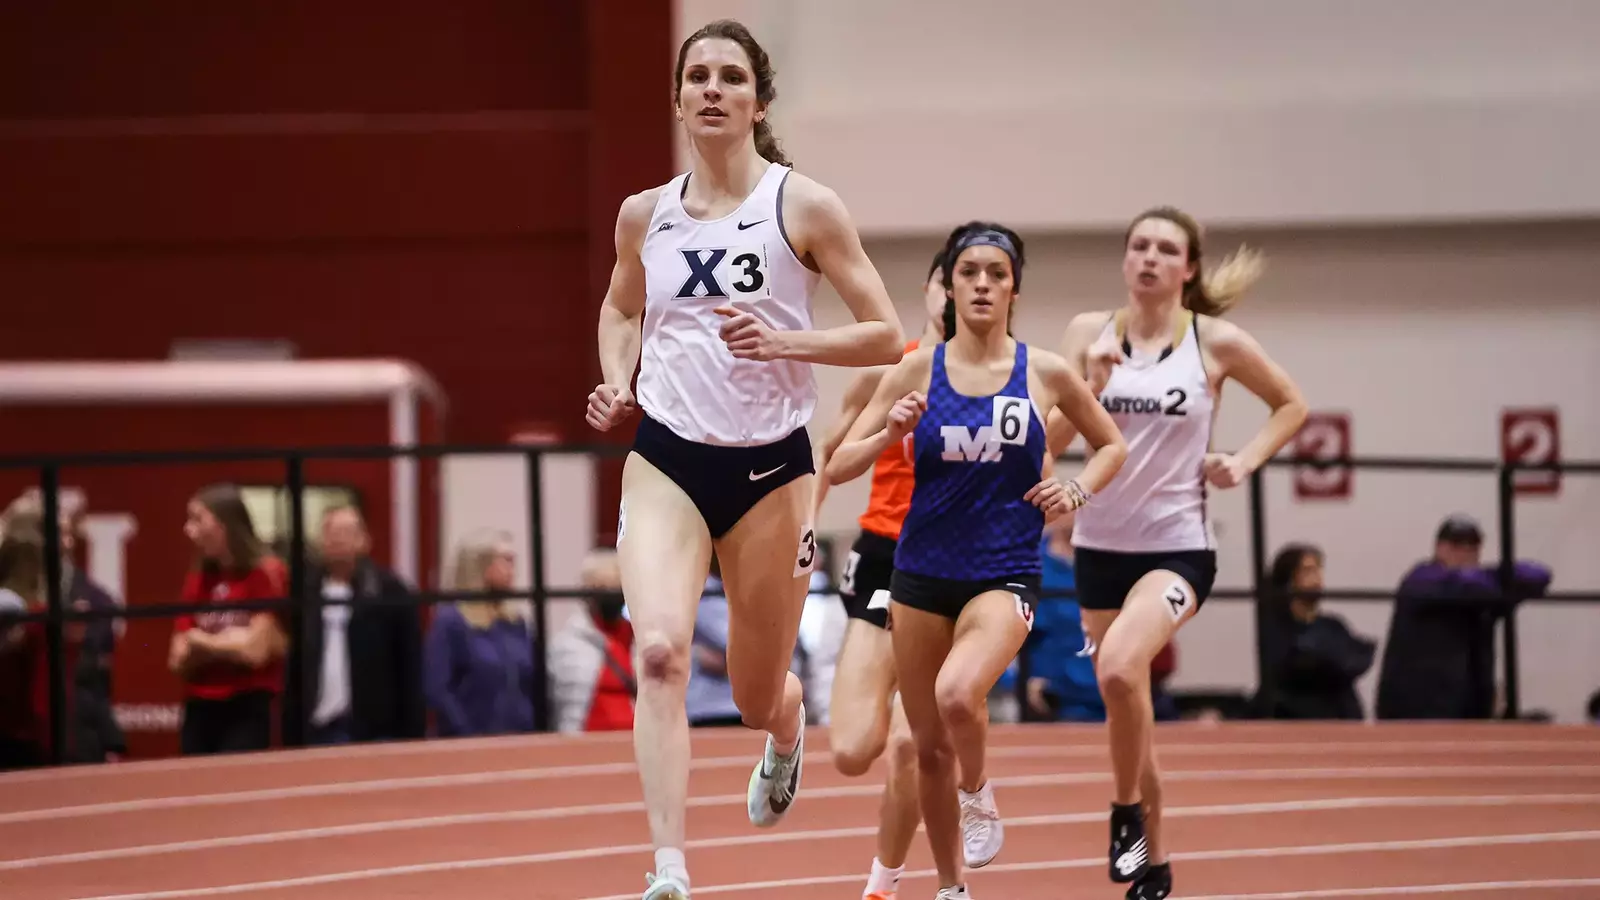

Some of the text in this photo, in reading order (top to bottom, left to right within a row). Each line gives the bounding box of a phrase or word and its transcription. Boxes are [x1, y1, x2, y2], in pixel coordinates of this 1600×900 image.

[673, 248, 730, 299] X
[731, 253, 764, 292] 3
[1001, 401, 1020, 440] 6
[1097, 396, 1161, 413] ASTOD
[1164, 388, 1186, 415] 2
[940, 425, 1003, 462] M
[1507, 417, 1552, 484] 2
[798, 529, 815, 568] 3
[1166, 587, 1185, 615] 2
